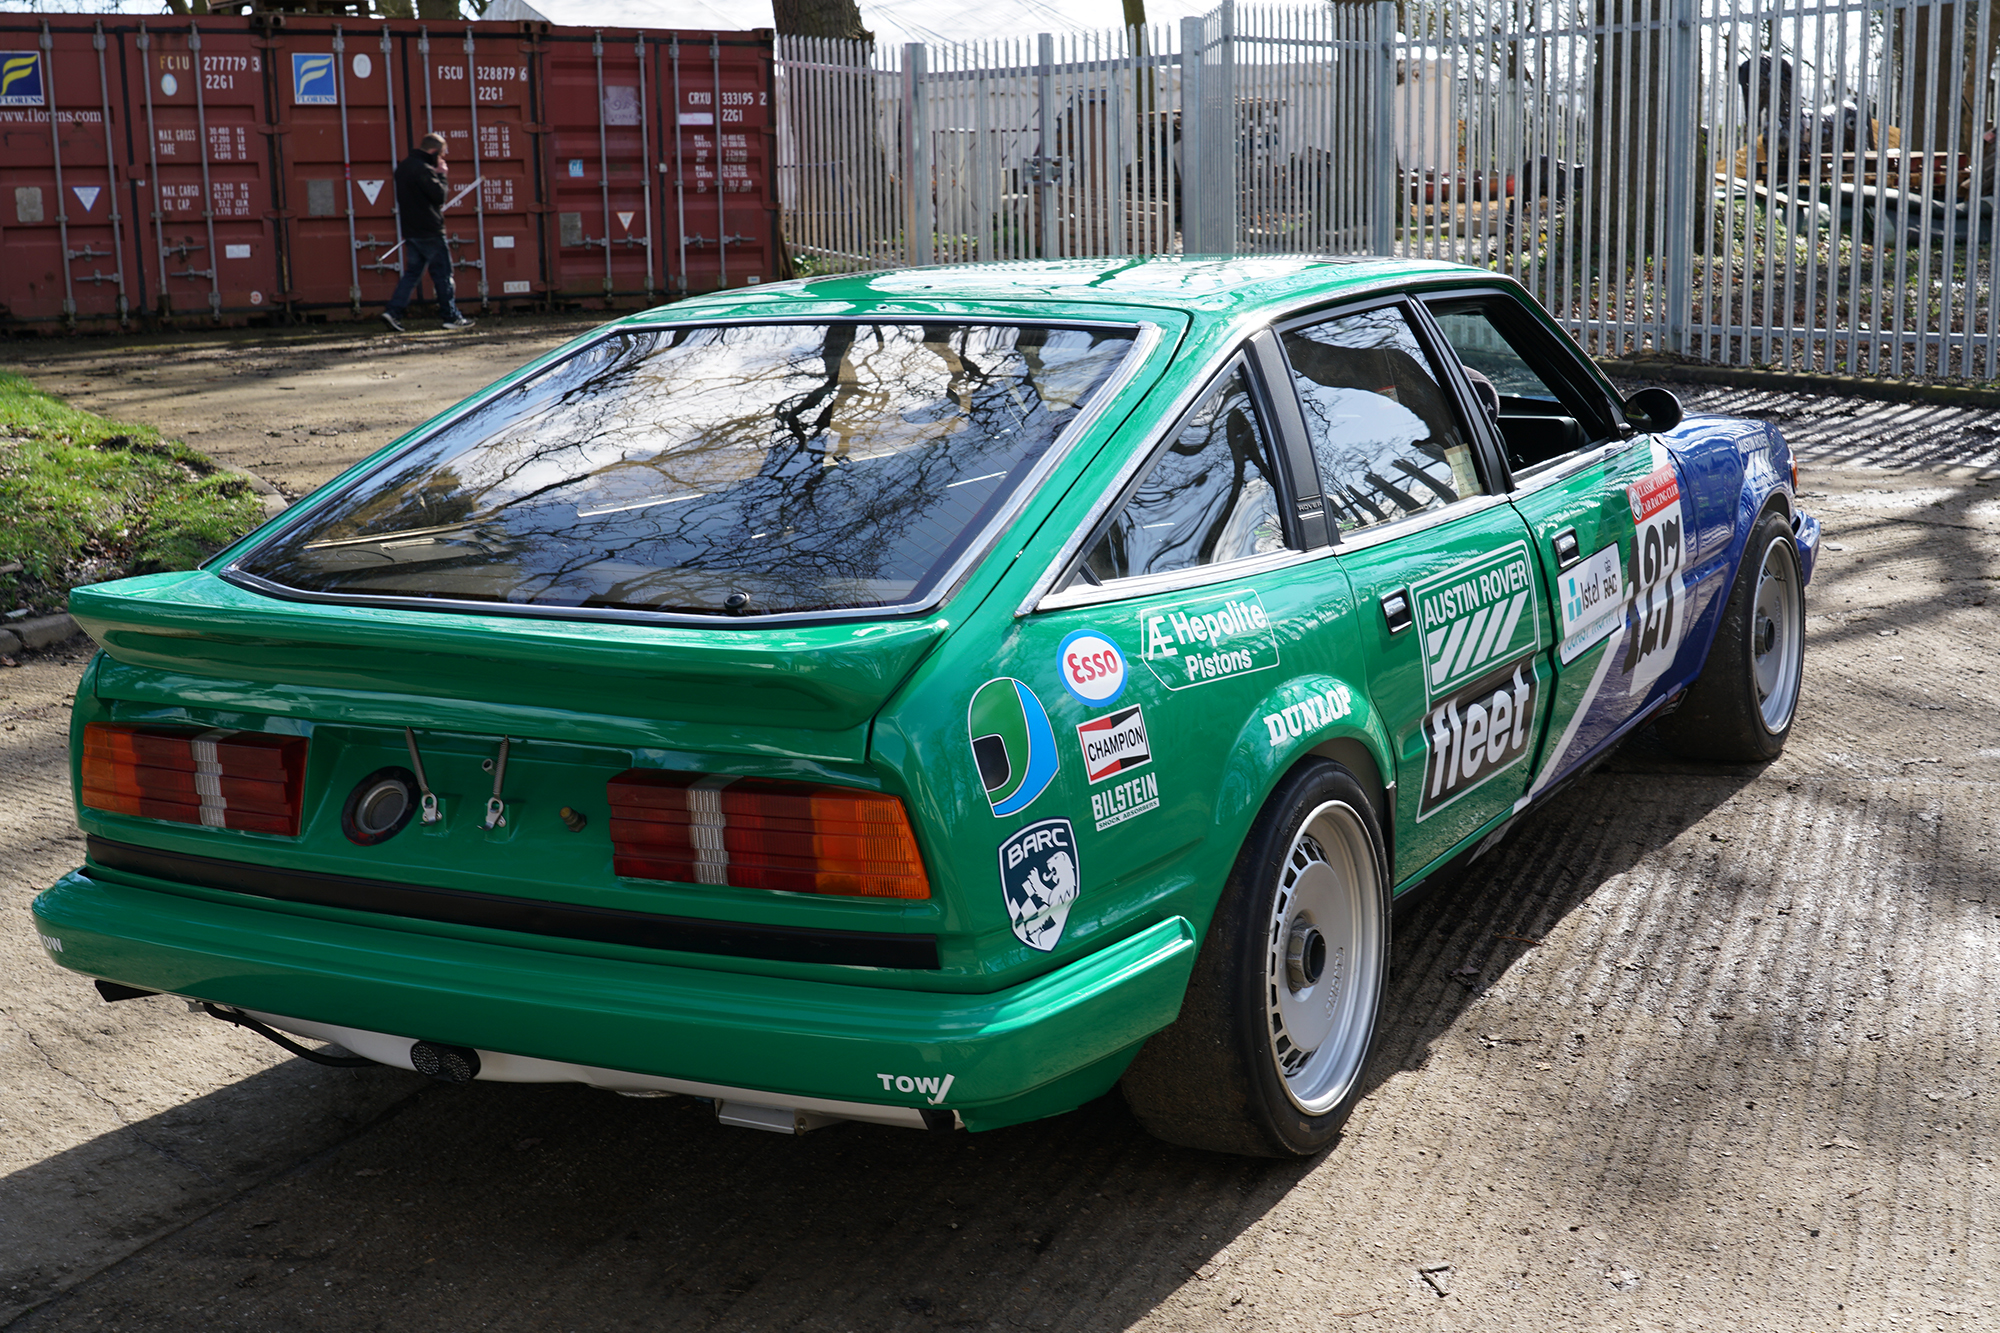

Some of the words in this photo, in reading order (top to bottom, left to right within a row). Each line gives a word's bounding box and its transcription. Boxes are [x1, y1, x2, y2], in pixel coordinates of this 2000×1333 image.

[160, 56, 189, 70] FCIU
[204, 56, 247, 71] 277779
[253, 57, 260, 71] 3
[438, 66, 463, 79] FSCU
[477, 66, 515, 80] 328879
[520, 67, 527, 80] 6
[205, 74, 234, 89] 22G1
[688, 91, 712, 105] CRXU
[722, 92, 754, 105] 333195
[760, 92, 766, 105] 2
[722, 109, 743, 121] 22G1
[176, 130, 196, 141] GROSS
[160, 143, 175, 155] TARE
[179, 185, 199, 196] CARGO
[1298, 501, 1322, 511] ROVER
[1424, 579, 1480, 629] AUSTIN
[1479, 560, 1529, 603] ROVER
[1602, 574, 1618, 599] RAC
[1168, 600, 1266, 647] Hepolite
[1185, 649, 1252, 681] Pistons
[1262, 686, 1352, 746] DUNLOP
[1430, 665, 1532, 800] fleet
[1087, 726, 1145, 762] CHAMPION
[1091, 772, 1159, 821] BILSTEIN
[1007, 827, 1068, 870] BARC
[877, 1073, 940, 1094] TOW
